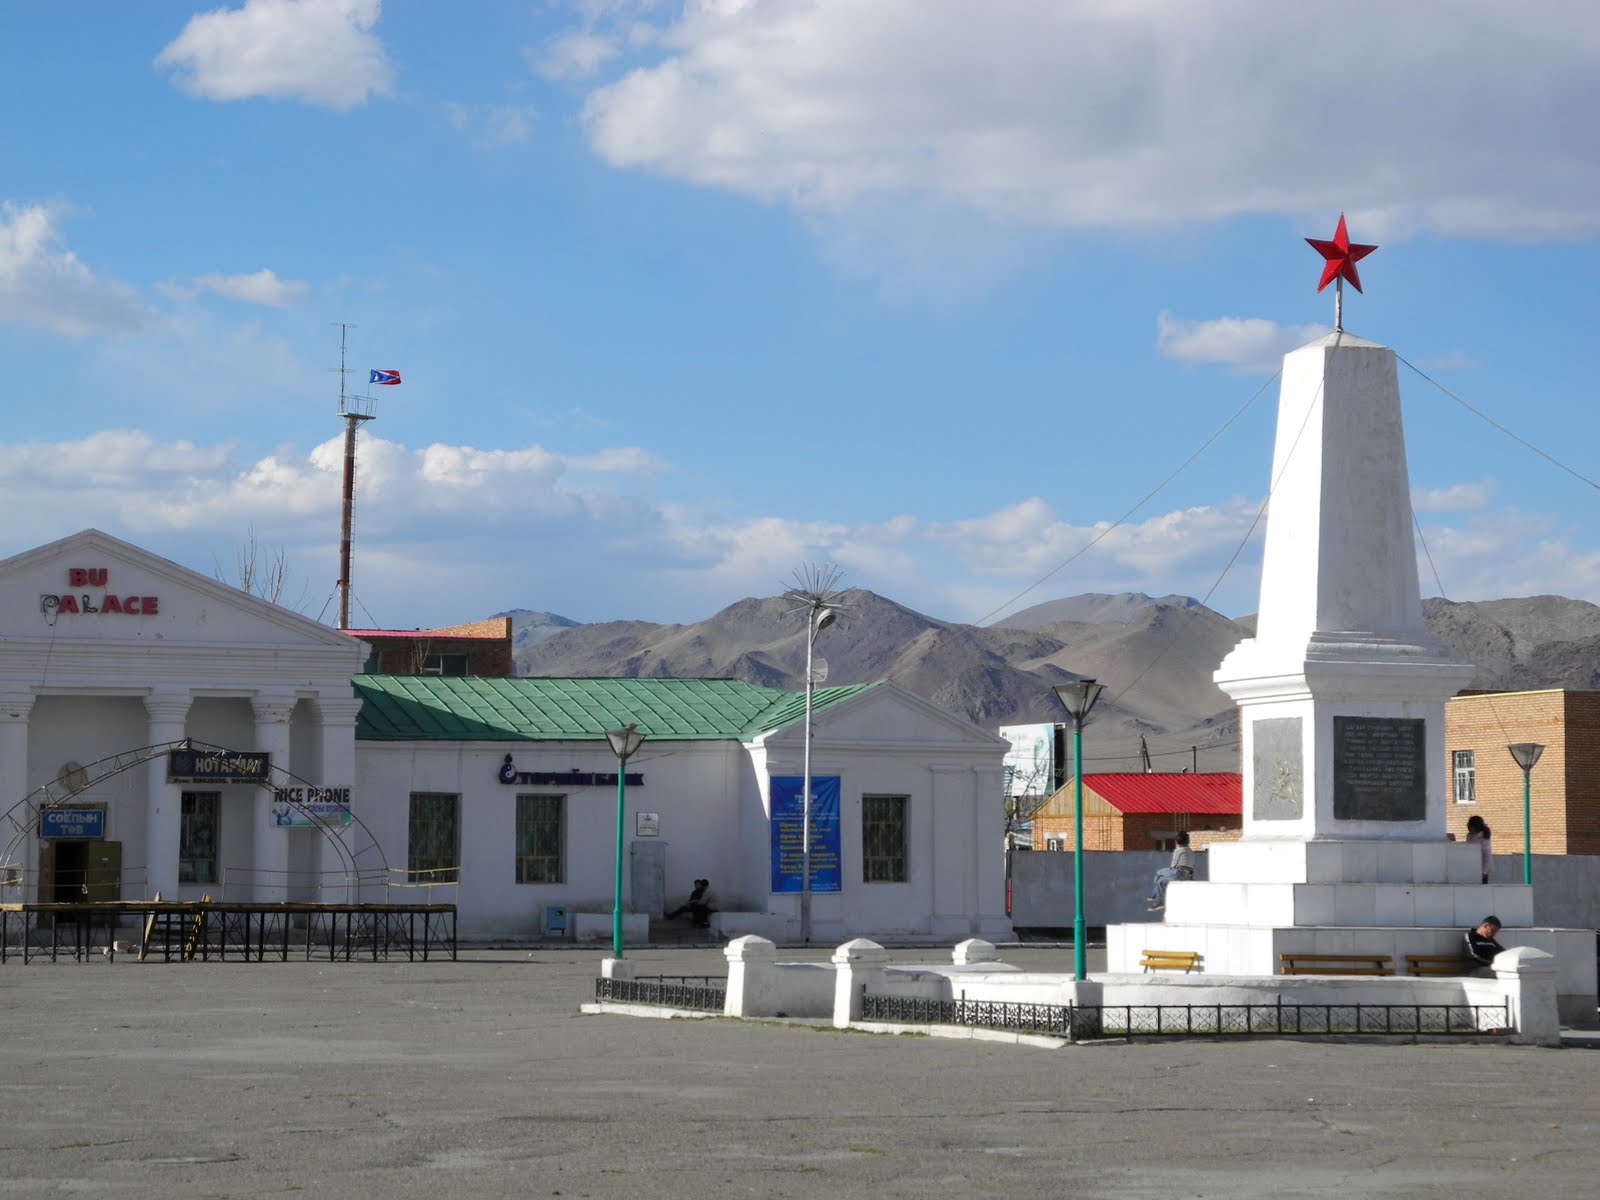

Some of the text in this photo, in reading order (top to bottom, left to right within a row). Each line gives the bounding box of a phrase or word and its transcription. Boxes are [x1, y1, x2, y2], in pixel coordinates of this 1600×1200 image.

[69, 568, 107, 587] BU
[274, 787, 350, 803] NICE PHONE
